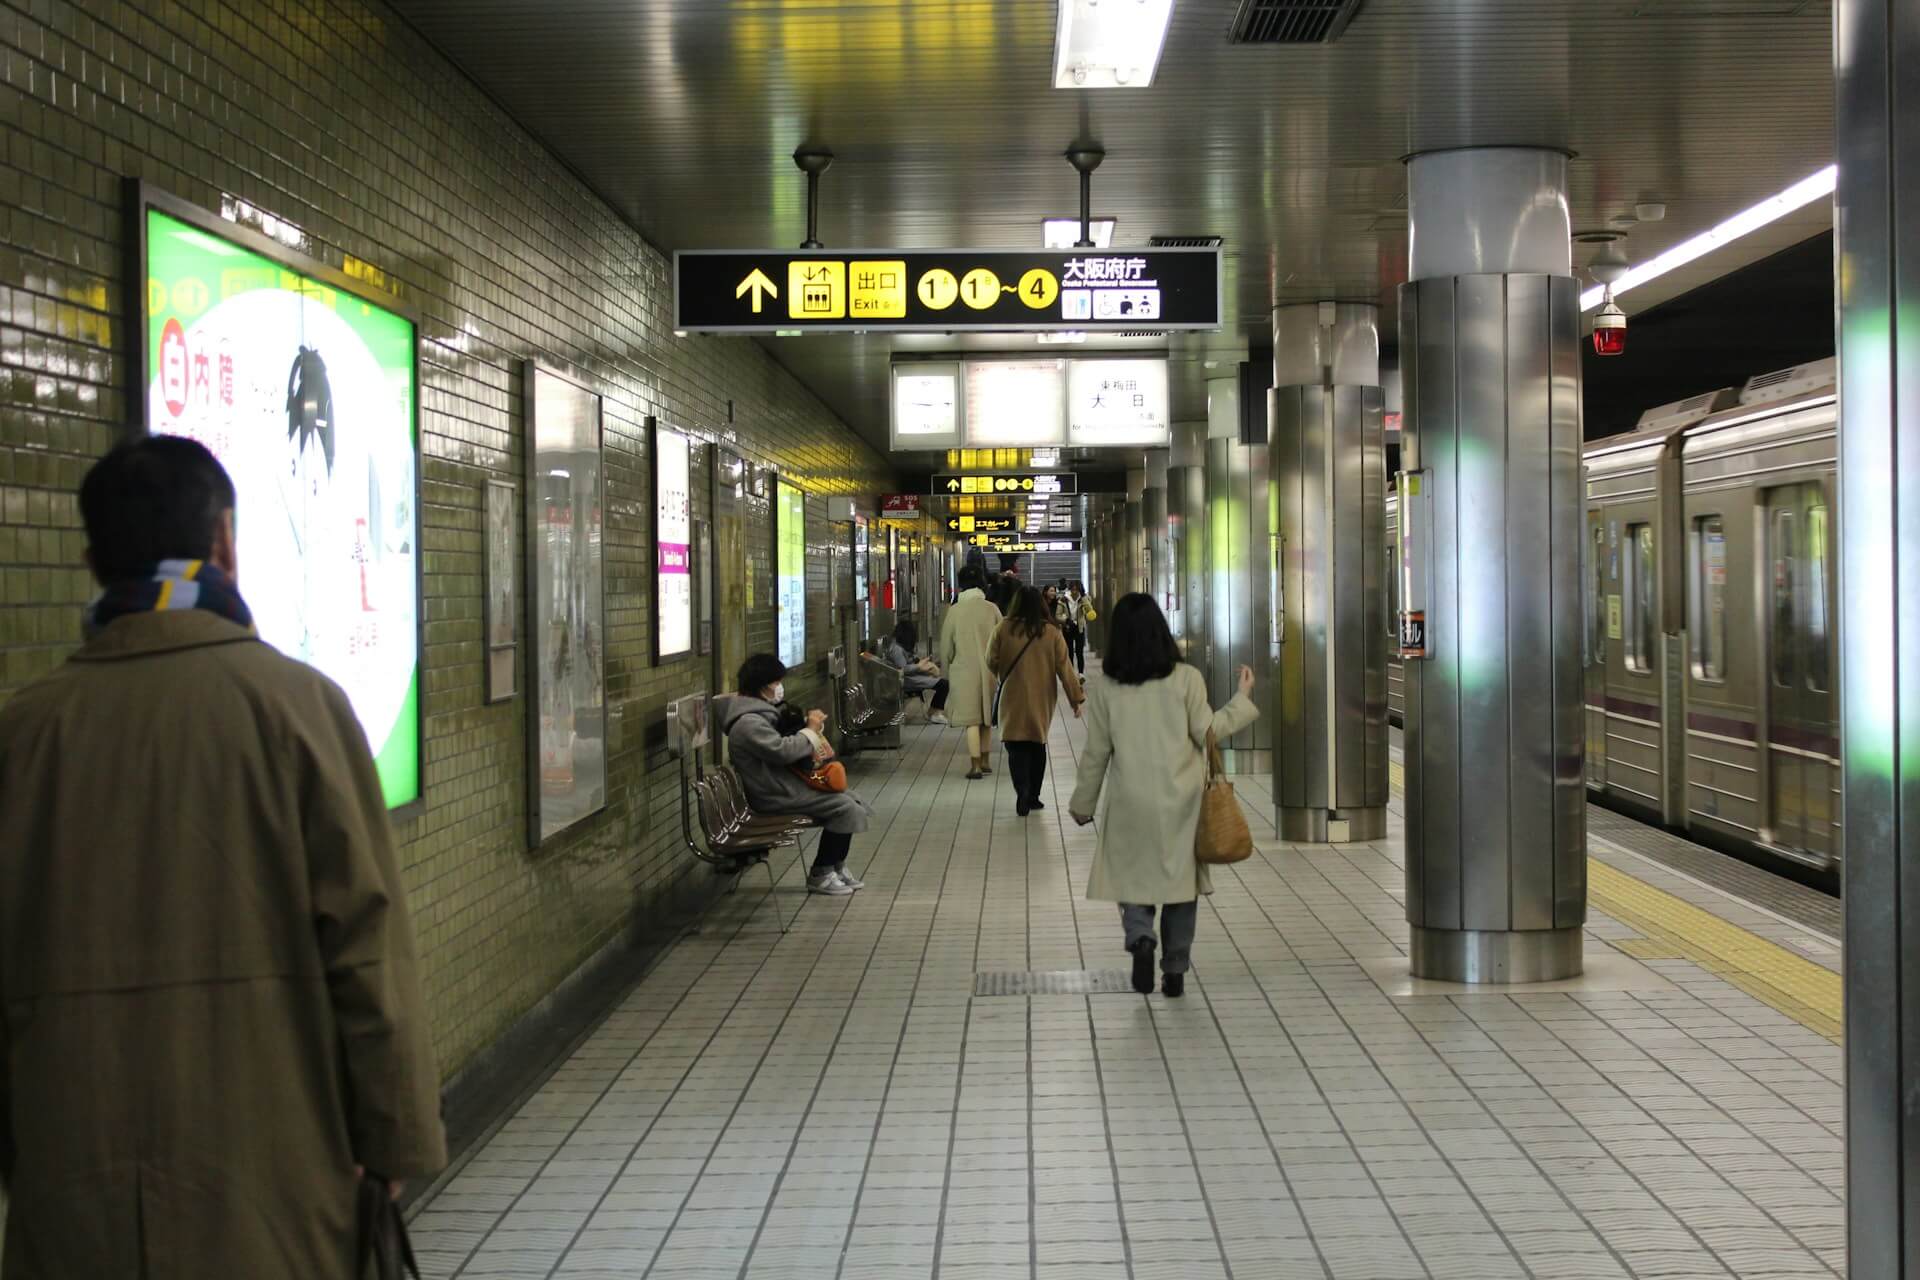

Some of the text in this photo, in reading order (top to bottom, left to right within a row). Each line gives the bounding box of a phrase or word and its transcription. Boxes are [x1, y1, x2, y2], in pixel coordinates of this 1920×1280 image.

[1064, 257, 1146, 280] 大阪府庁
[858, 272, 896, 290] 出口
[1030, 277, 1045, 299] 4
[854, 298, 878, 310] Exit
[163, 332, 234, 408] 白内障
